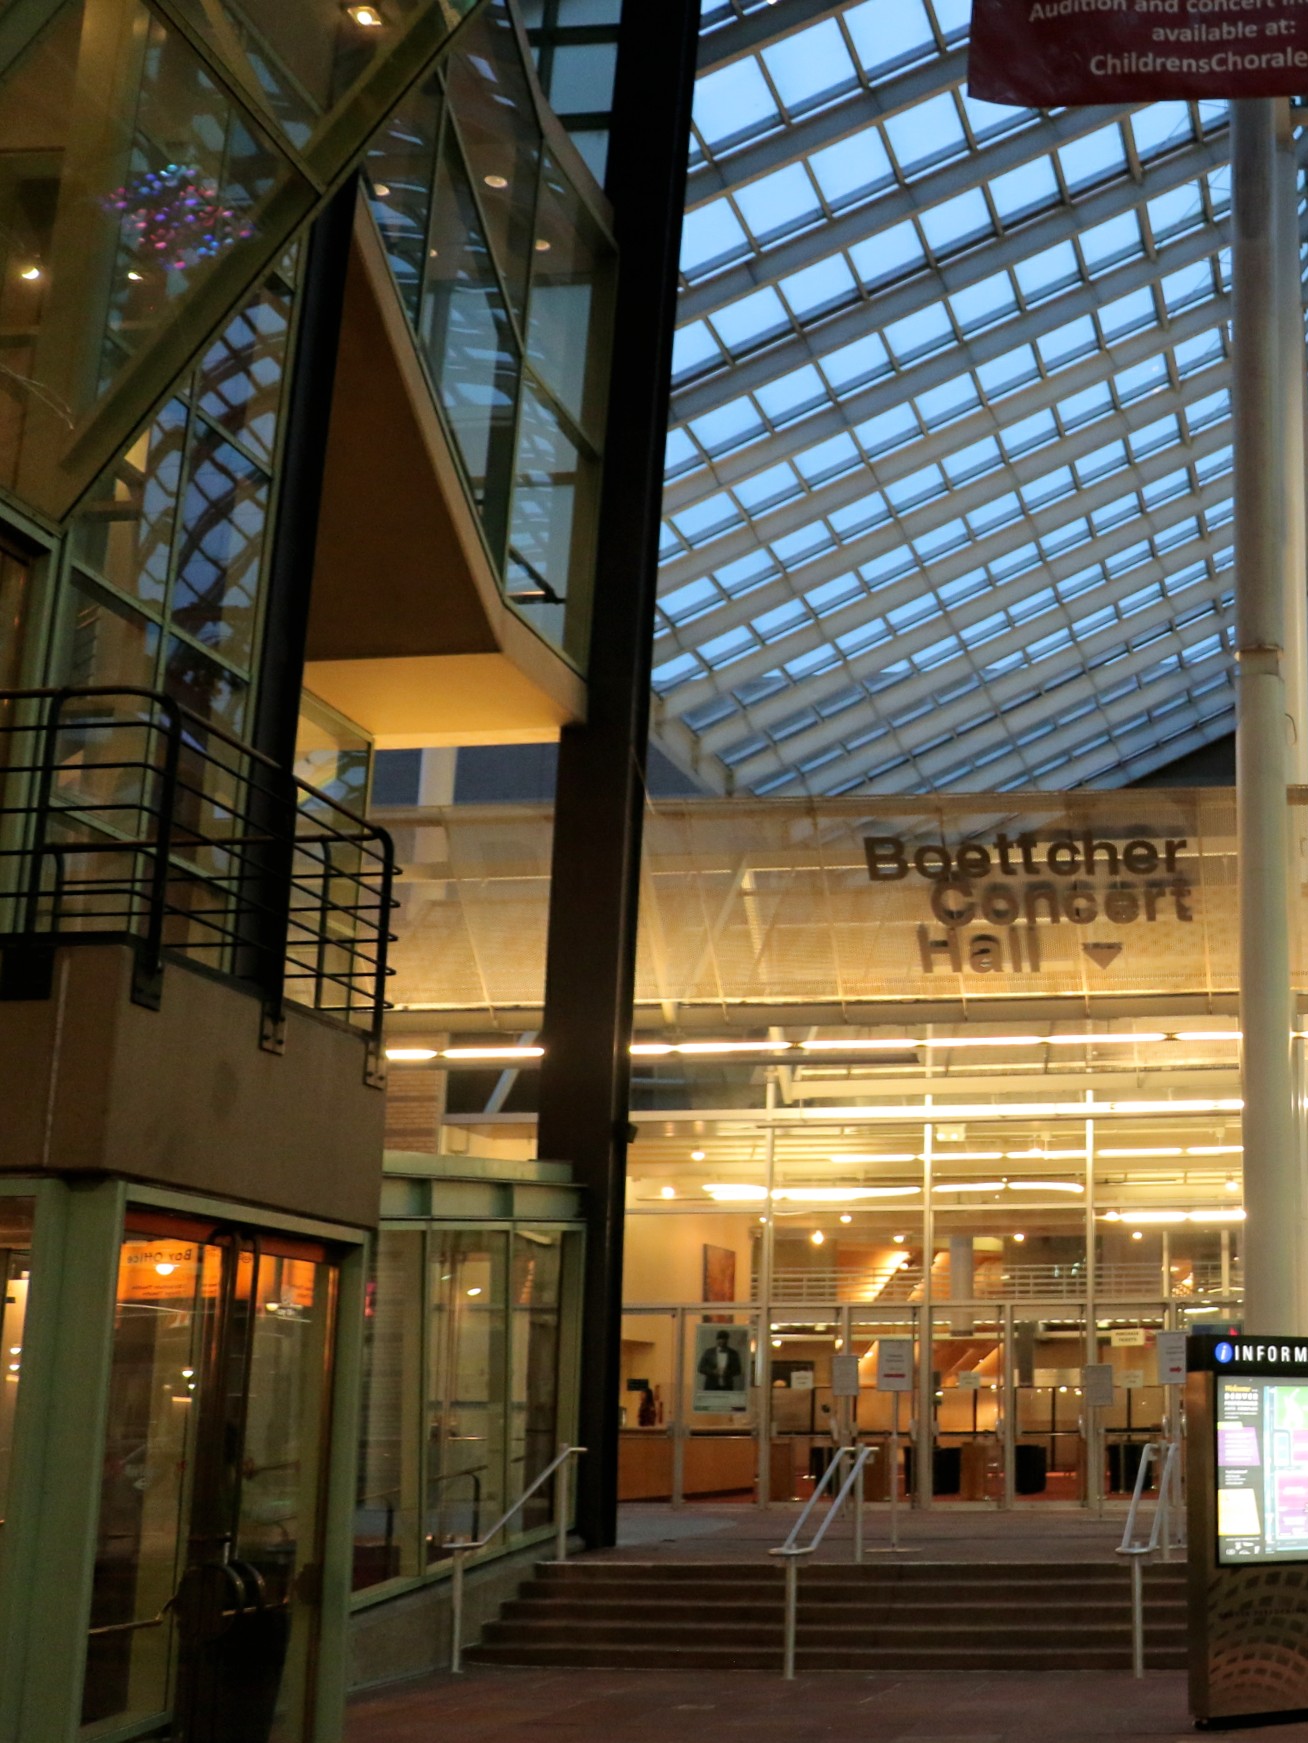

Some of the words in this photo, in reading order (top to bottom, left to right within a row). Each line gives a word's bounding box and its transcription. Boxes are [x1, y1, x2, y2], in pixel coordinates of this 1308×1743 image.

[1028, 0, 1127, 22] Audition
[1134, 0, 1178, 13] and
[1152, 21, 1258, 42] available
[1265, 18, 1297, 37] at:
[864, 830, 1188, 881] Boettcher
[930, 876, 1193, 927] Concert
[917, 922, 1041, 973] Hall
